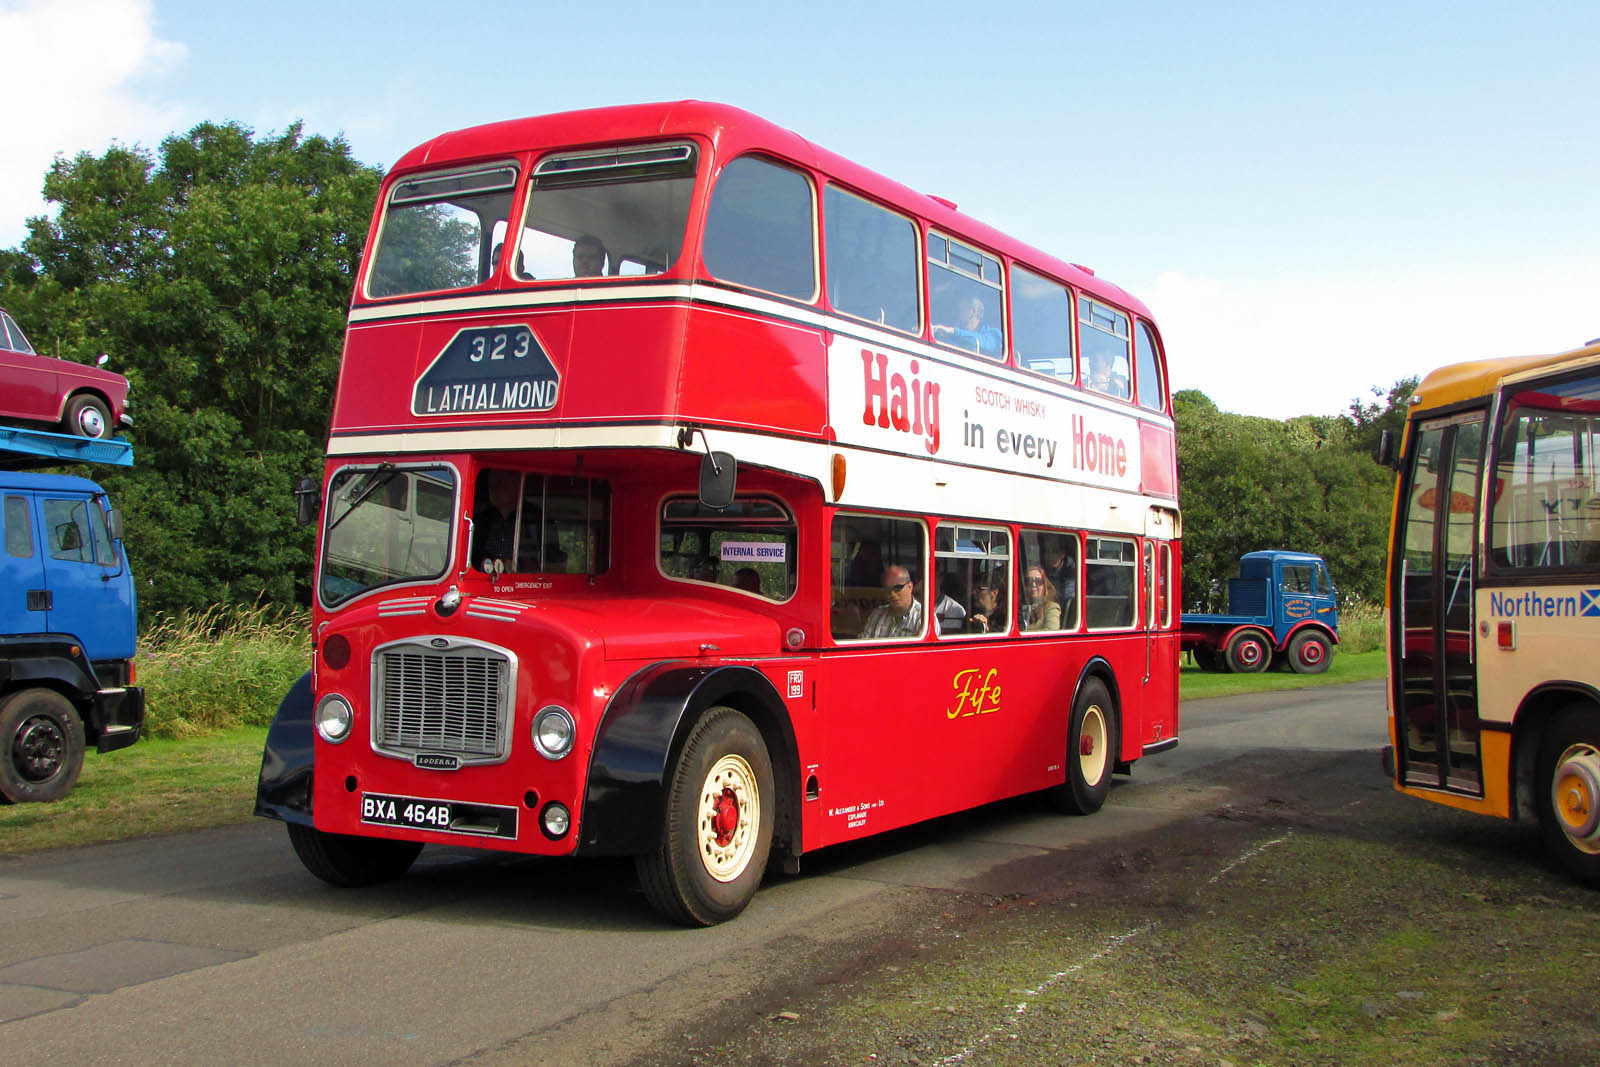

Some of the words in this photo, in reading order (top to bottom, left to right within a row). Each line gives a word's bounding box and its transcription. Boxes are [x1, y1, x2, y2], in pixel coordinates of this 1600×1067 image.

[470, 331, 530, 362] 323
[427, 380, 559, 412] LATHALMOND
[861, 349, 940, 455] Haig
[976, 386, 1010, 411] SCOTCH
[1014, 398, 1047, 419] WHISKY
[964, 410, 984, 449] in
[996, 428, 1057, 468] every
[1072, 413, 1127, 477] Home
[722, 547, 754, 557] INTERNAL
[756, 548, 784, 557] SERVICE
[1491, 591, 1576, 617] Northern
[947, 668, 1001, 719] Fife
[364, 799, 397, 820] BXA
[403, 804, 450, 825] 464B
